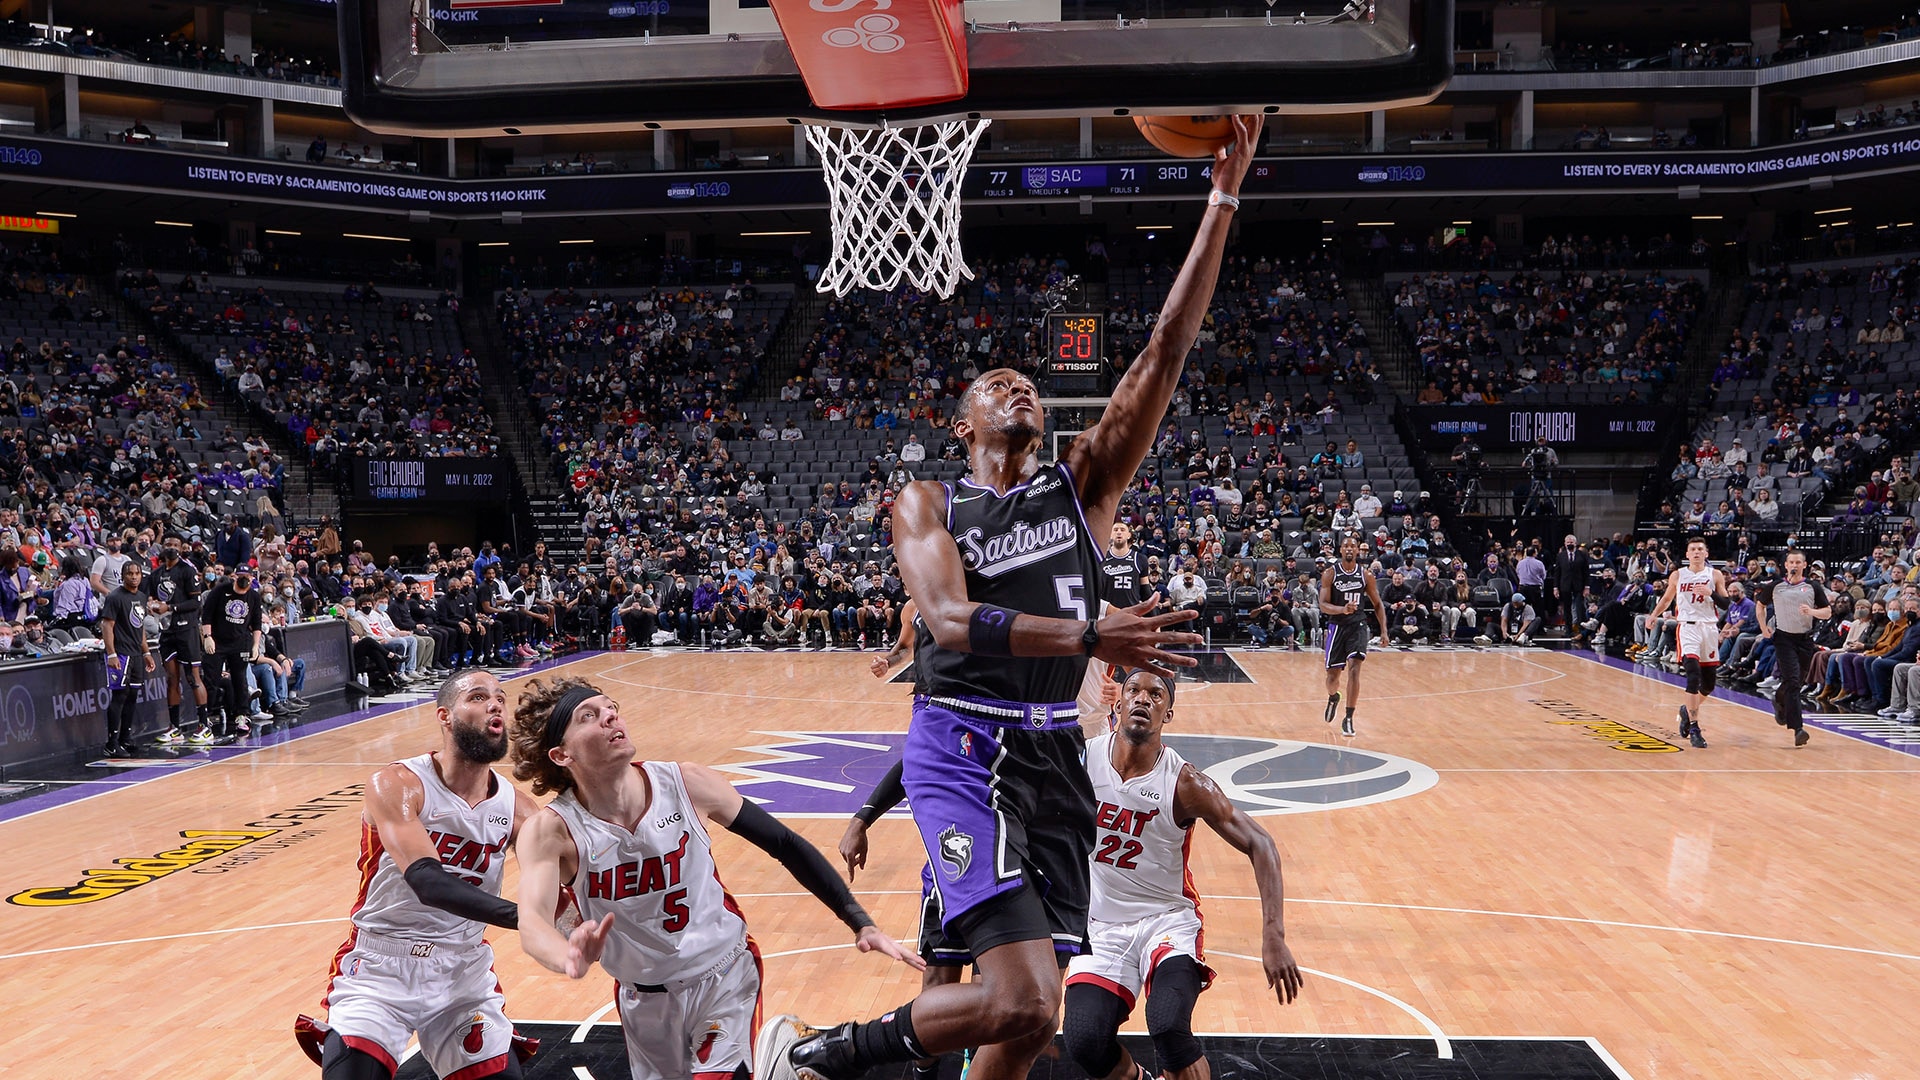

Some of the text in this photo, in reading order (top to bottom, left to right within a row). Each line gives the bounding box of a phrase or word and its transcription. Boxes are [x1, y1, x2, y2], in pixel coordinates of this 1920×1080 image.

[430, 8, 479, 21] 140 KHTK
[1564, 139, 1920, 176] LISTEN TO EVERY SACRAMENTO KINGS GAME ON SPORTS 1140
[989, 171, 1008, 184] 77
[1051, 169, 1081, 182] SAC
[1120, 168, 1135, 181] 71
[1158, 167, 1188, 180] 3RD
[1256, 168, 1268, 176] 20
[1386, 166, 1425, 181] 1140
[188, 166, 546, 203] LISTEN TO EVERY SACRAMENTO KINGS GAME ON SPORTS 1140 KHTK
[694, 182, 731, 197] 1140
[1065, 318, 1096, 333] 4:29
[1059, 333, 1091, 359] 20
[1064, 363, 1099, 371] TISSOT
[1438, 421, 1460, 433] GATHER
[1460, 421, 1478, 433] AGAIN
[1509, 412, 1575, 442] ERIC CHURCH
[1609, 421, 1624, 432] MAY
[1637, 421, 1655, 432] 2022
[368, 460, 425, 486] ERIC CHURCH
[445, 474, 461, 486] MAY
[473, 473, 493, 486] 2022
[376, 487, 399, 499] GATHER
[400, 487, 418, 499] AGAIN
[1026, 478, 1062, 498] dialpad
[955, 515, 1077, 572] Sactown
[1114, 575, 1133, 590] 25
[1053, 574, 1087, 622] 5
[1344, 592, 1361, 605] 40
[1691, 593, 1705, 604] 14
[53, 688, 96, 720] HOME
[1140, 788, 1160, 800] UKG
[488, 814, 508, 825] UKG
[657, 812, 682, 829] UKG
[1096, 800, 1160, 838] EAT
[252, 829, 327, 850] Union
[1094, 834, 1144, 870] 22
[192, 851, 275, 874] Credit
[588, 830, 690, 901] HEAT
[663, 887, 690, 933] 5
